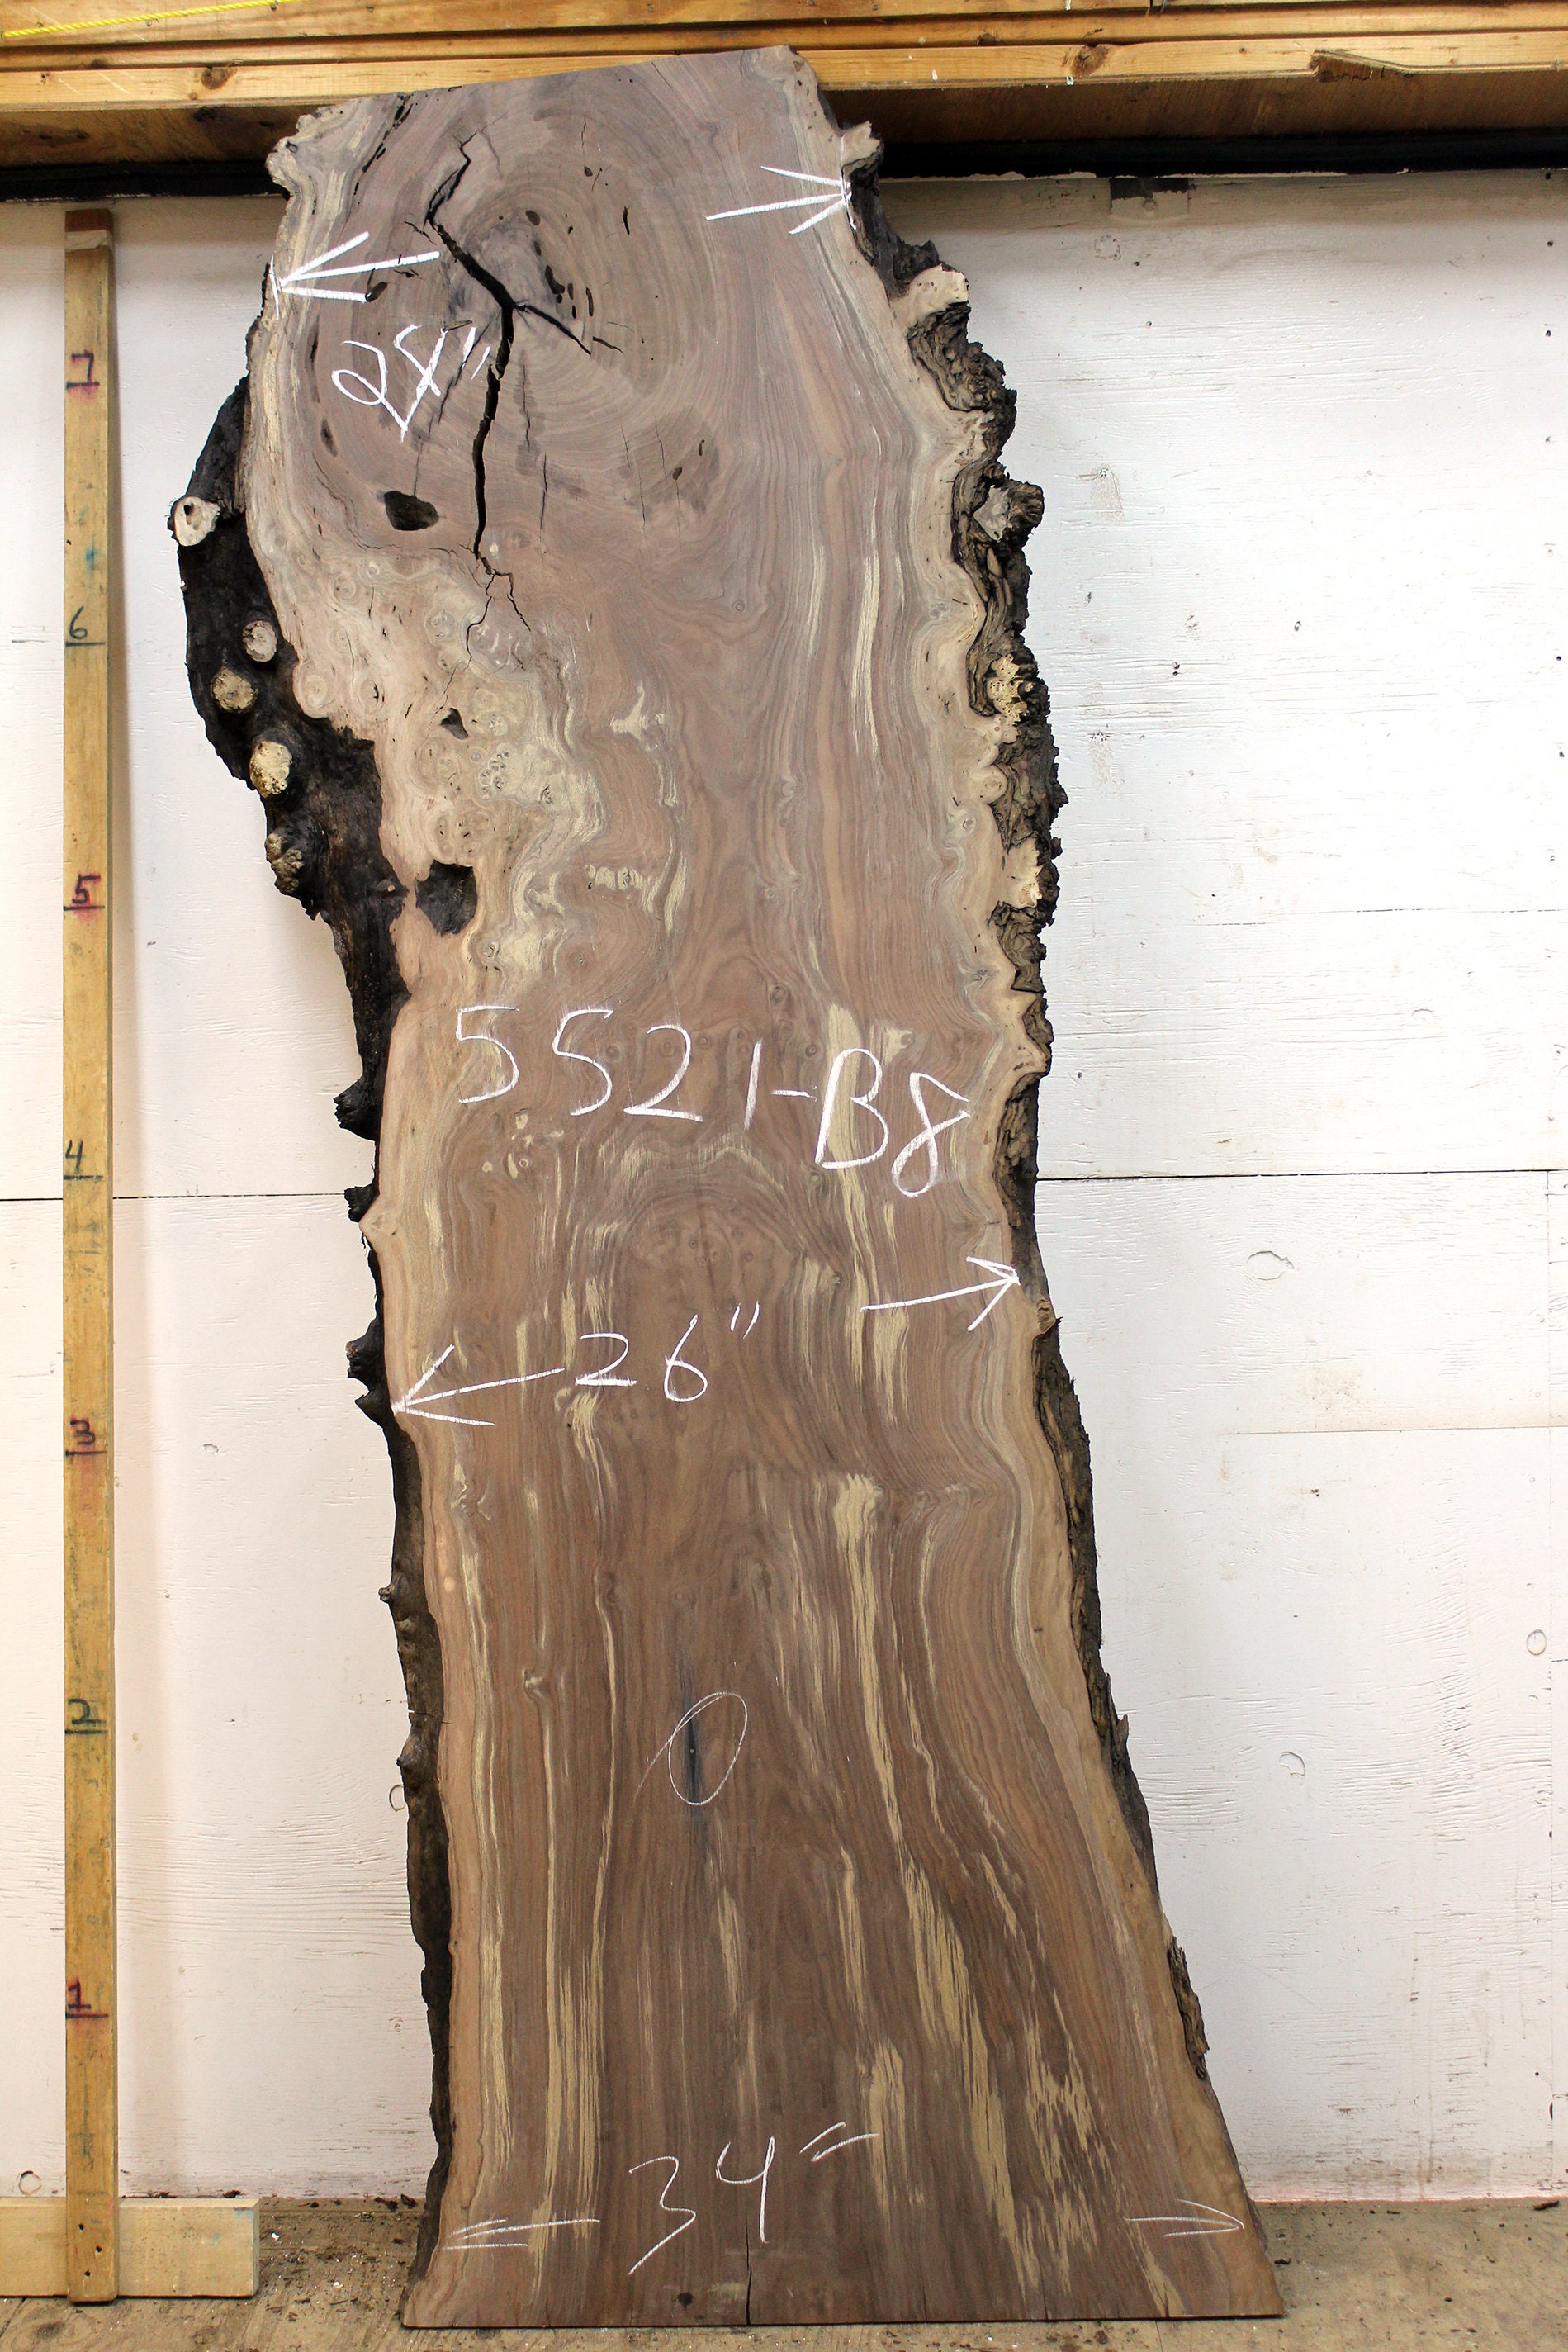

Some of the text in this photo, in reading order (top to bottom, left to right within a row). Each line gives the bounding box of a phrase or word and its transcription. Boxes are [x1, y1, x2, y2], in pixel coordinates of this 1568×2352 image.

[70, 351, 94, 383] 7
[68, 606, 88, 640] 6
[71, 875, 101, 904] 5
[65, 1140, 85, 1173] 4
[574, 1300, 761, 1403] 26"
[69, 1418, 97, 1446] 3
[68, 1699, 107, 1725] 2
[67, 1982, 92, 2010] 1
